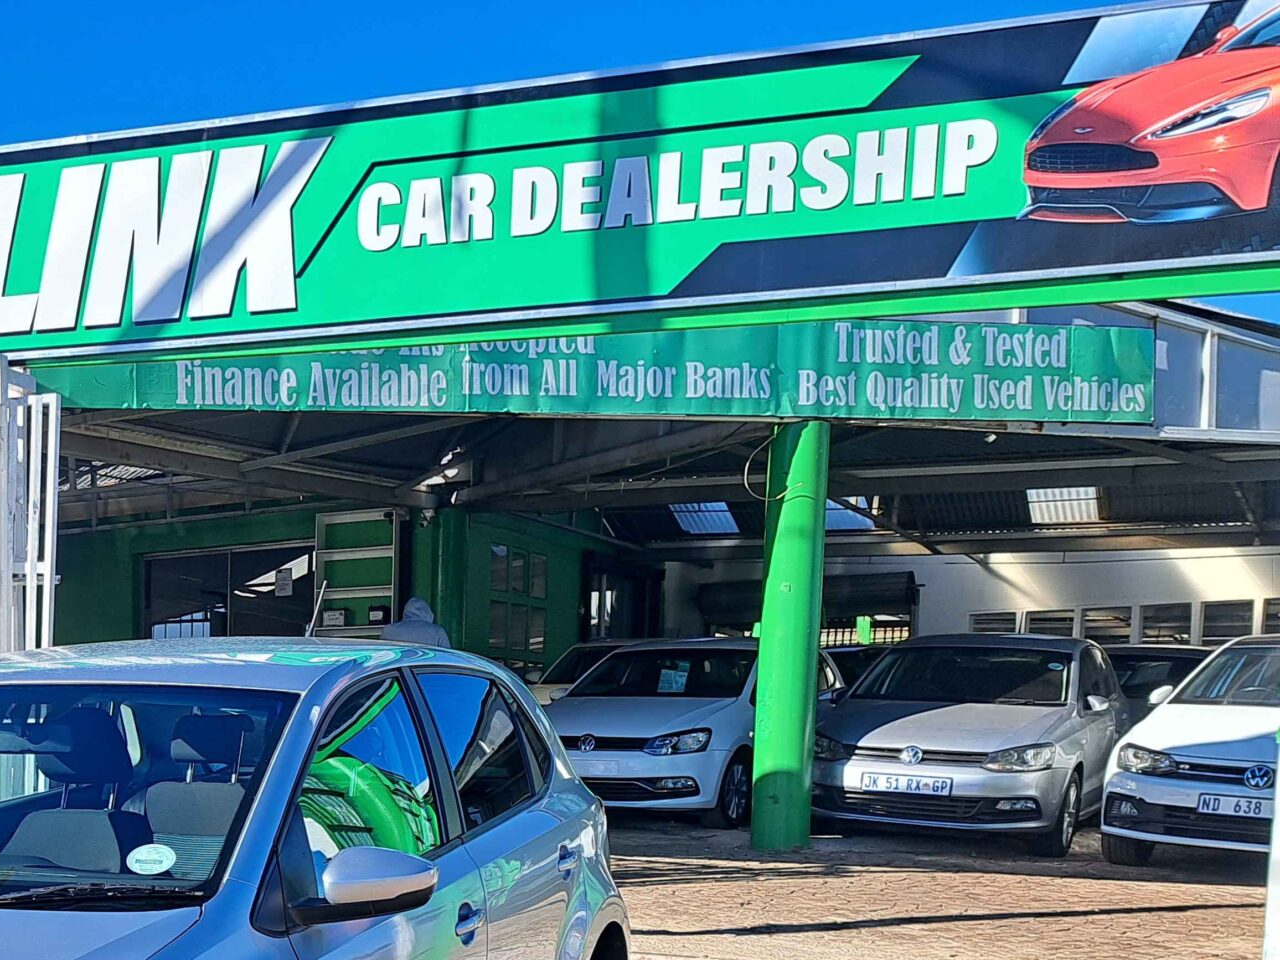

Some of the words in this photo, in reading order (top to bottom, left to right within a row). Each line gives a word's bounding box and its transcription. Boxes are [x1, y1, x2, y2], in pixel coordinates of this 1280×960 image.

[356, 172, 495, 252] CAR
[511, 118, 999, 237] DEALERSHIP
[834, 322, 939, 365] Trusted
[949, 325, 971, 366] &
[982, 326, 1068, 369] Tested
[175, 359, 298, 406] Finance
[307, 361, 448, 407] Available
[460, 358, 530, 397] from
[539, 359, 579, 396] All
[596, 359, 677, 403] Major
[685, 361, 772, 399] Banks
[797, 369, 857, 407] Best
[866, 371, 964, 413] Quality
[972, 374, 1033, 411] Used
[1042, 375, 1145, 413] Vehicles
[864, 775, 880, 789] JK
[885, 777, 900, 790] 51
[906, 778, 921, 791] RX
[932, 779, 948, 793] GP
[1201, 796, 1221, 812] ND
[1233, 799, 1263, 816] 638
